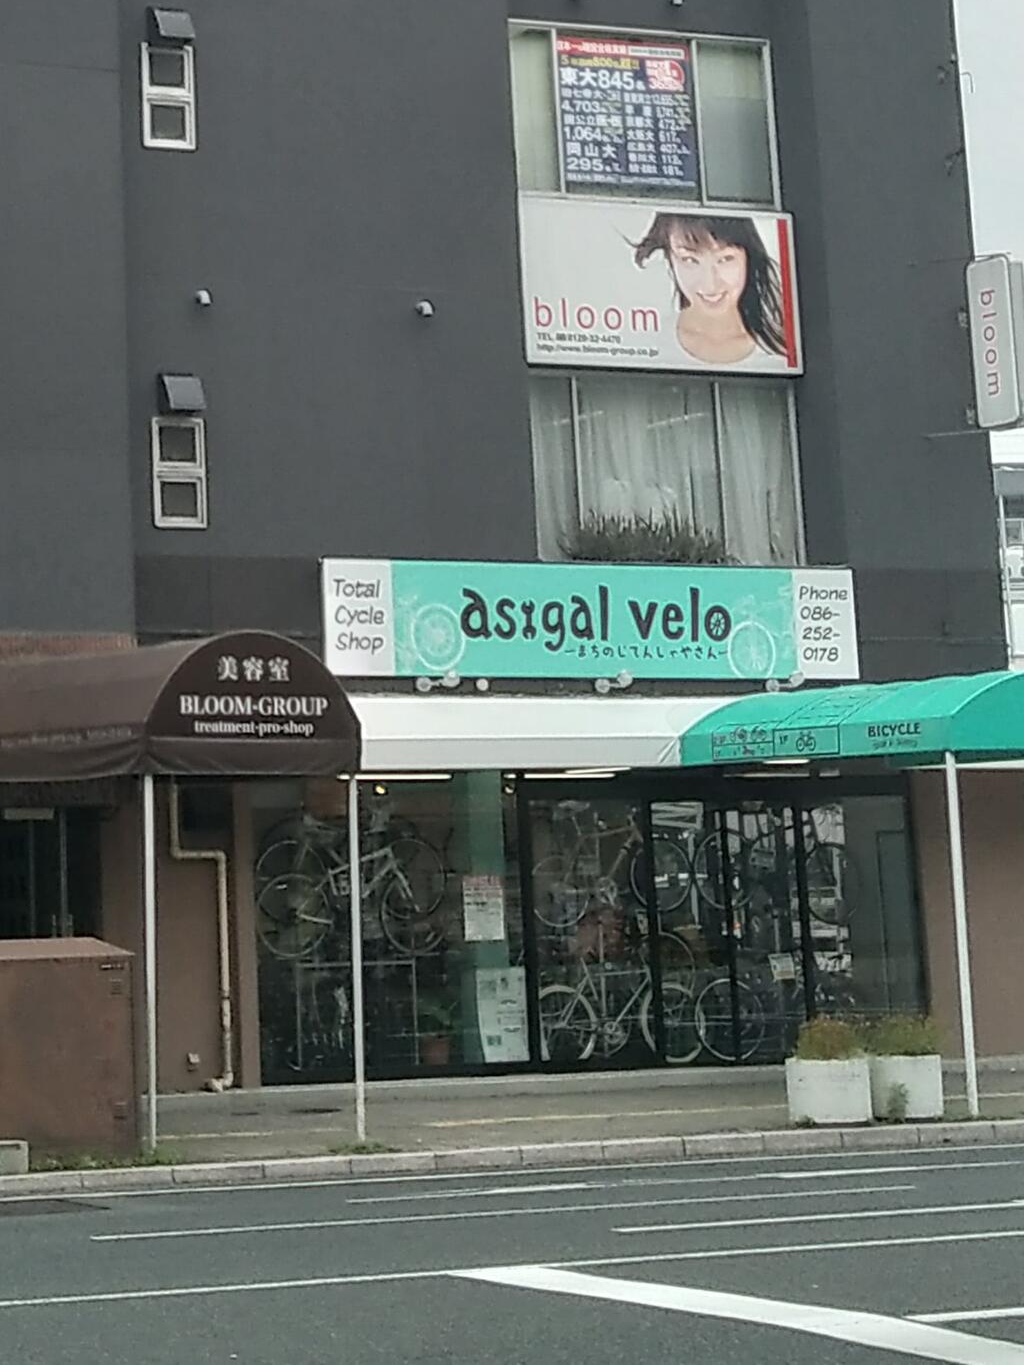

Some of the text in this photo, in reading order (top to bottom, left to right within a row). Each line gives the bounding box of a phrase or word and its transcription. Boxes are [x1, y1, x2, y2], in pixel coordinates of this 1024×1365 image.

[533, 296, 659, 332] bloom
[980, 289, 1001, 397] bloom
[333, 577, 381, 600] Total
[799, 585, 849, 603] Phone
[334, 604, 386, 627] Cycle
[629, 586, 732, 643] velo
[800, 605, 841, 622] 086-
[335, 631, 385, 655] Shop
[802, 626, 841, 642] 252-
[803, 645, 840, 662] 0178
[218, 655, 291, 682] 美容室
[868, 722, 921, 739] BICYCLE
